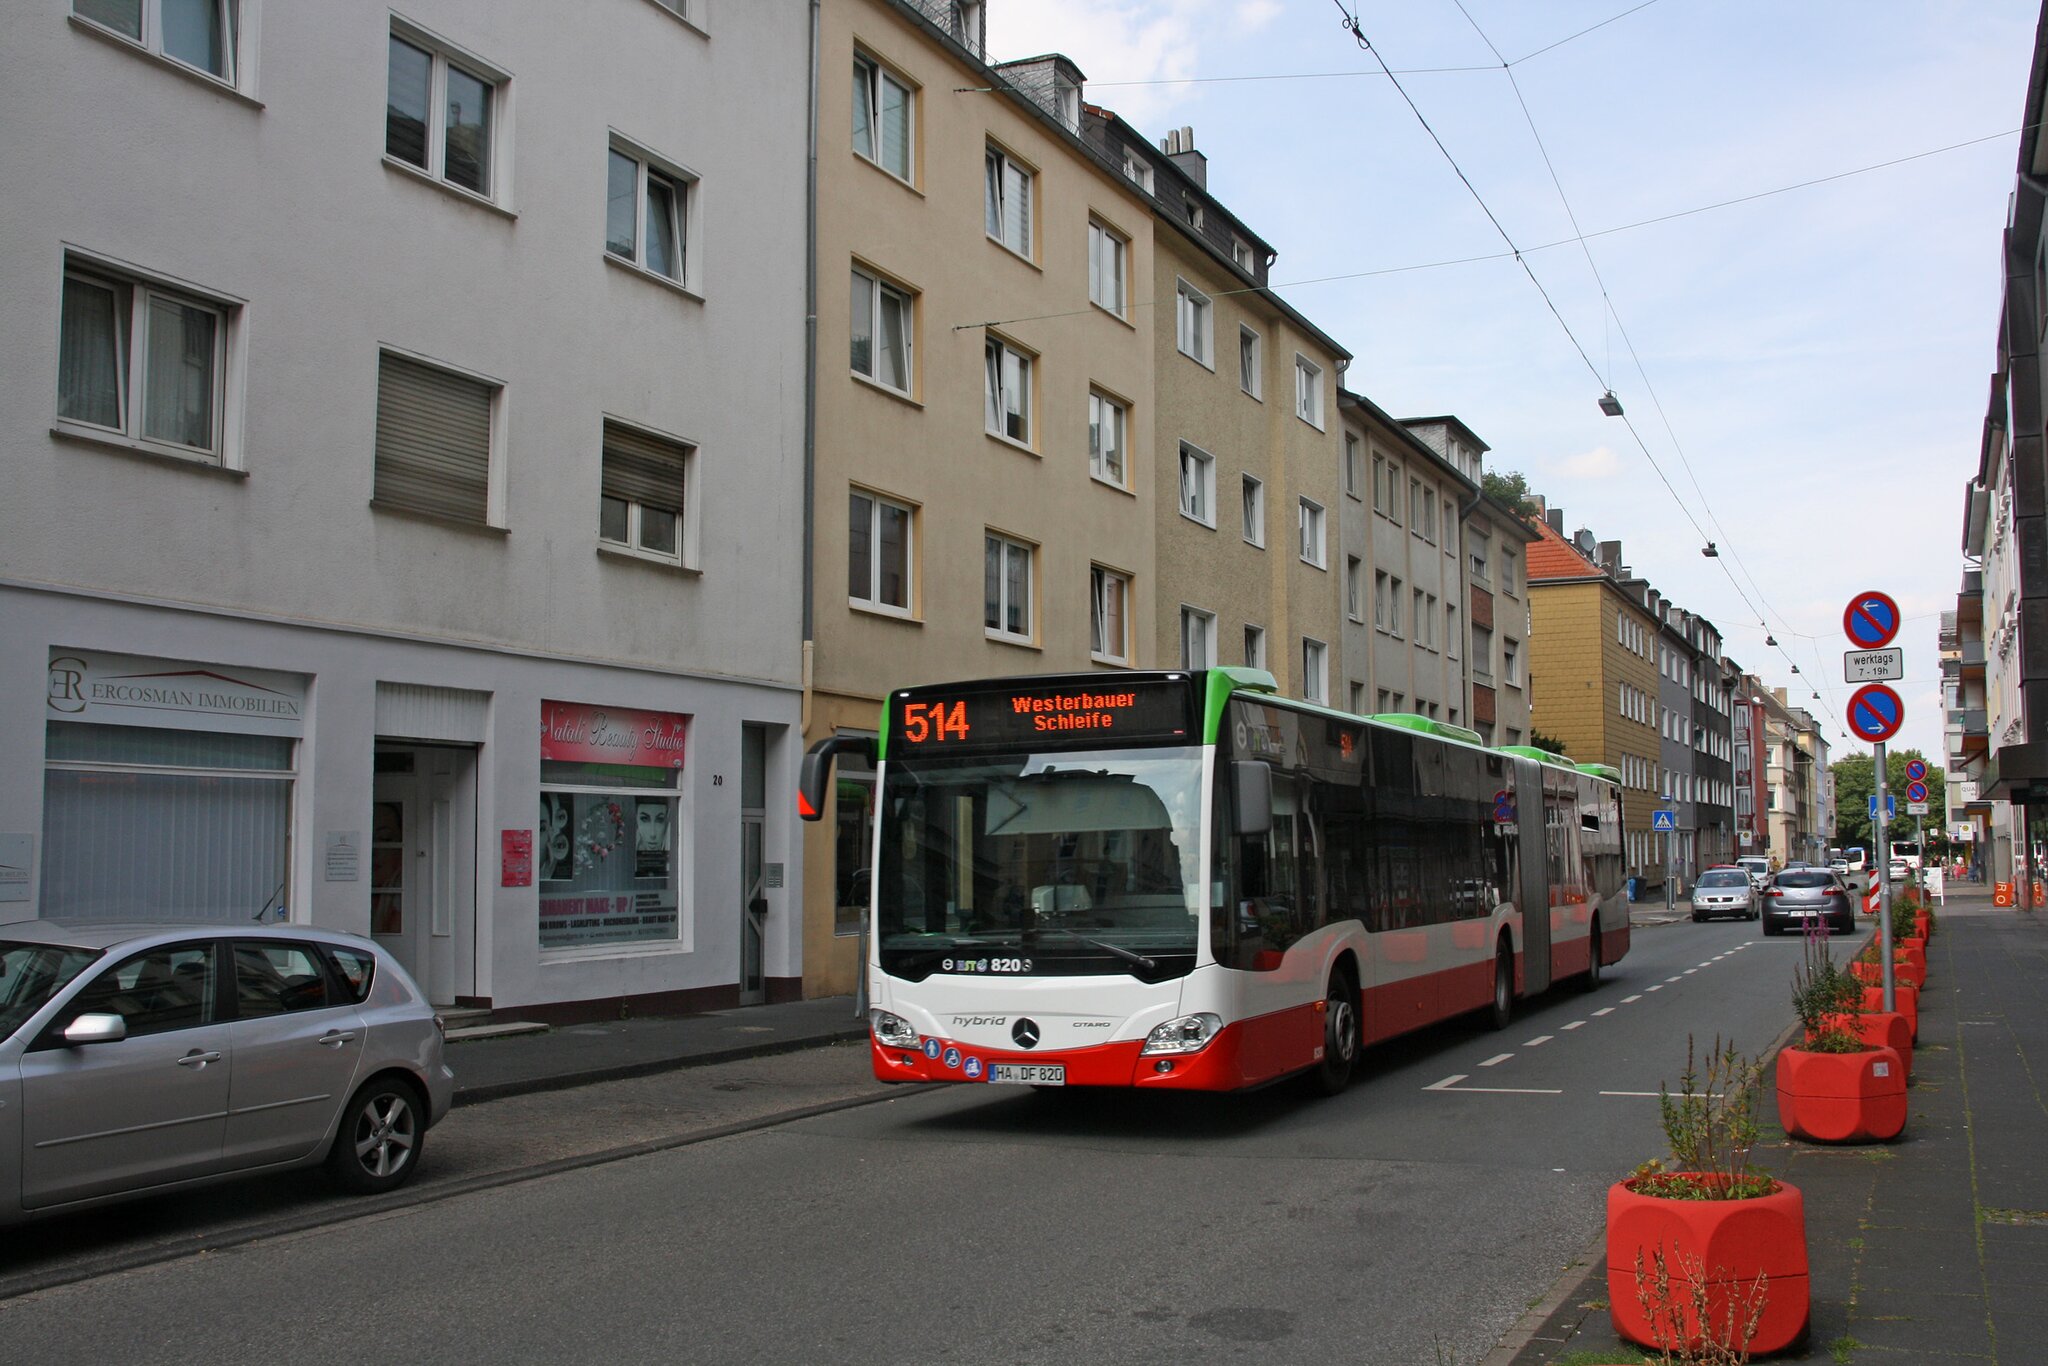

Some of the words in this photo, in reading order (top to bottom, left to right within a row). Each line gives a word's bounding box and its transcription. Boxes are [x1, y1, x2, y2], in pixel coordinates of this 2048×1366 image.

[1853, 654, 1894, 666] werktags
[1859, 668, 1864, 676] 7
[1872, 667, 1888, 675] 19h
[91, 683, 193, 705] ERCOSMAN
[198, 693, 299, 715] IMMOBILIEN
[1011, 692, 1136, 713] Westerbauer
[904, 701, 970, 743] 514
[1034, 712, 1113, 731] Schleife
[541, 708, 585, 745] Natali
[589, 710, 640, 761] Beauty
[644, 717, 683, 750] Studio
[713, 774, 722, 786] 20
[991, 958, 1021, 972] 820
[952, 1016, 1007, 1027] hybrid
[995, 1066, 1013, 1080] HA
[1020, 1067, 1037, 1080] DF
[1039, 1067, 1063, 1081] 820
